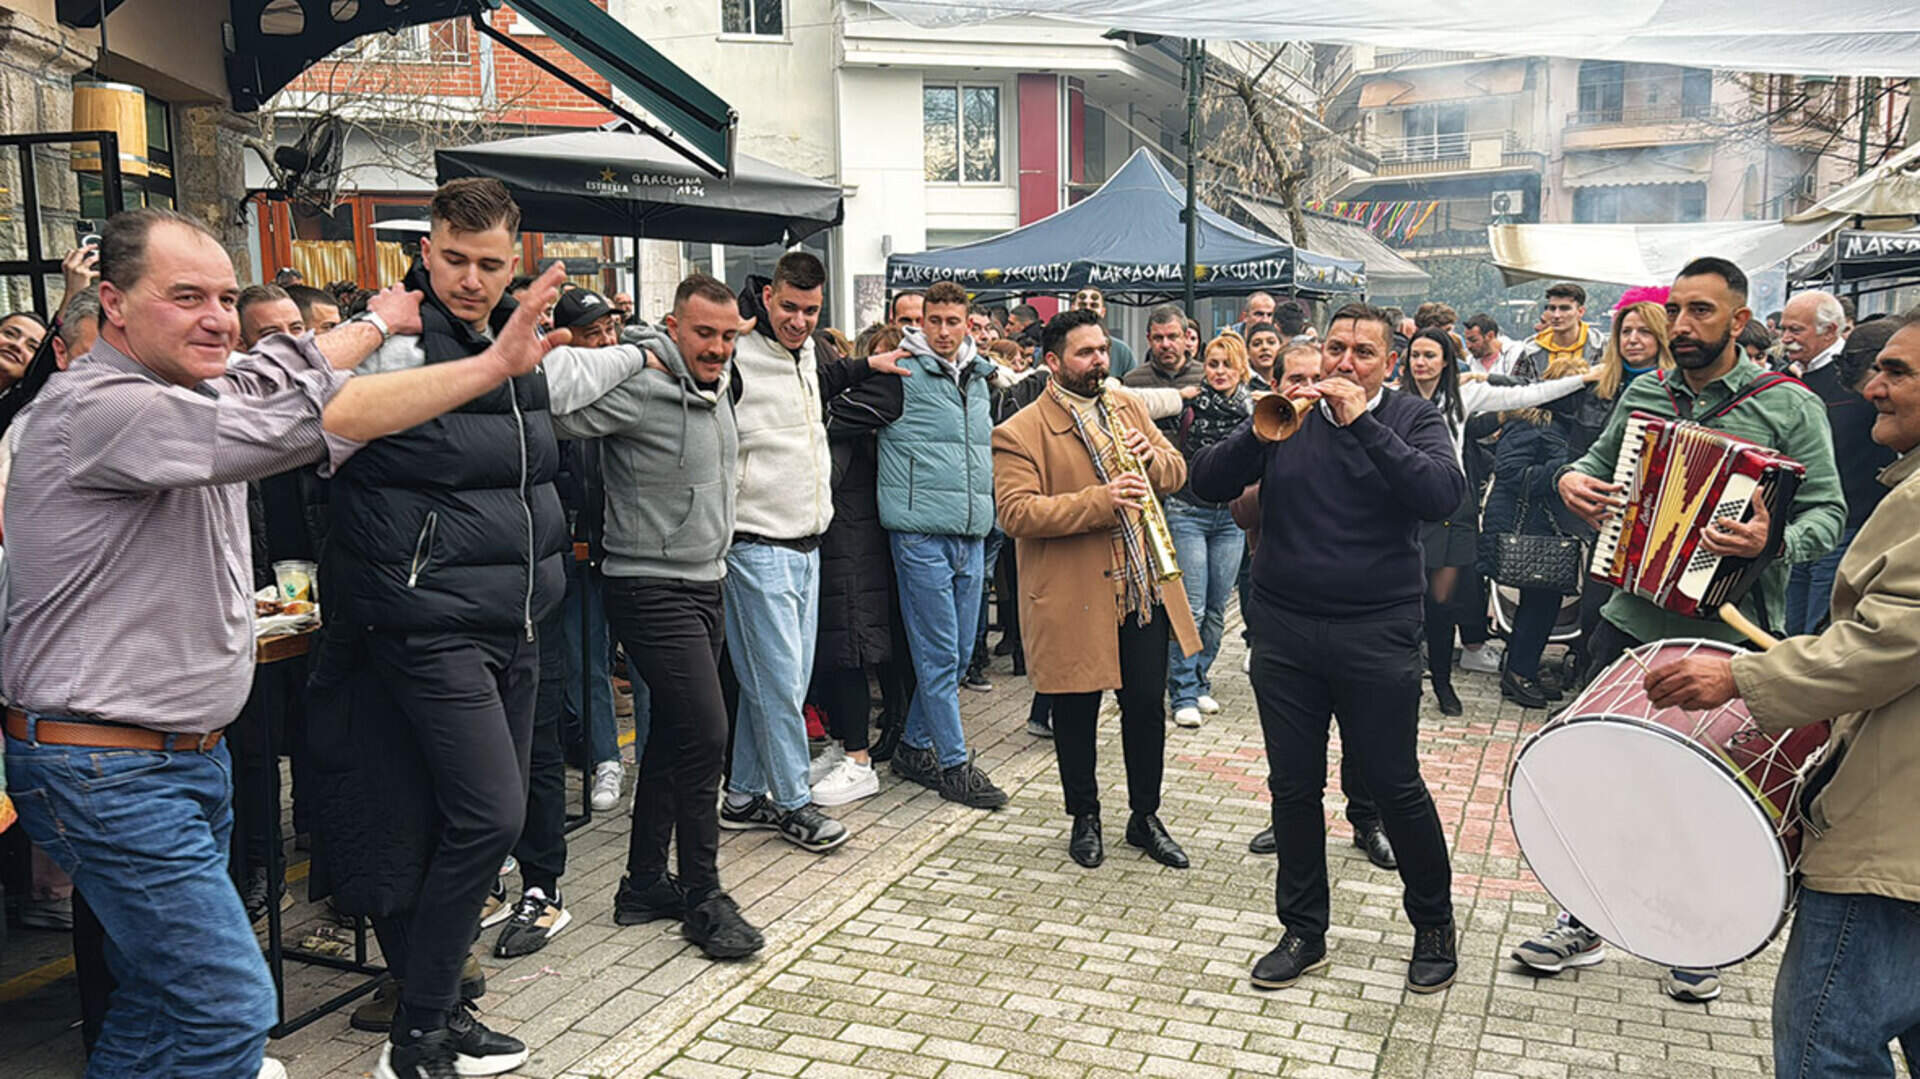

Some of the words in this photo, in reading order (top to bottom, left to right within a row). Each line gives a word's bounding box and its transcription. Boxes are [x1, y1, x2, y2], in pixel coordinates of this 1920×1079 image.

[586, 181, 629, 193] ESTRELLA
[1003, 262, 1072, 283] SECURITY
[1210, 258, 1286, 282] SECURITY
